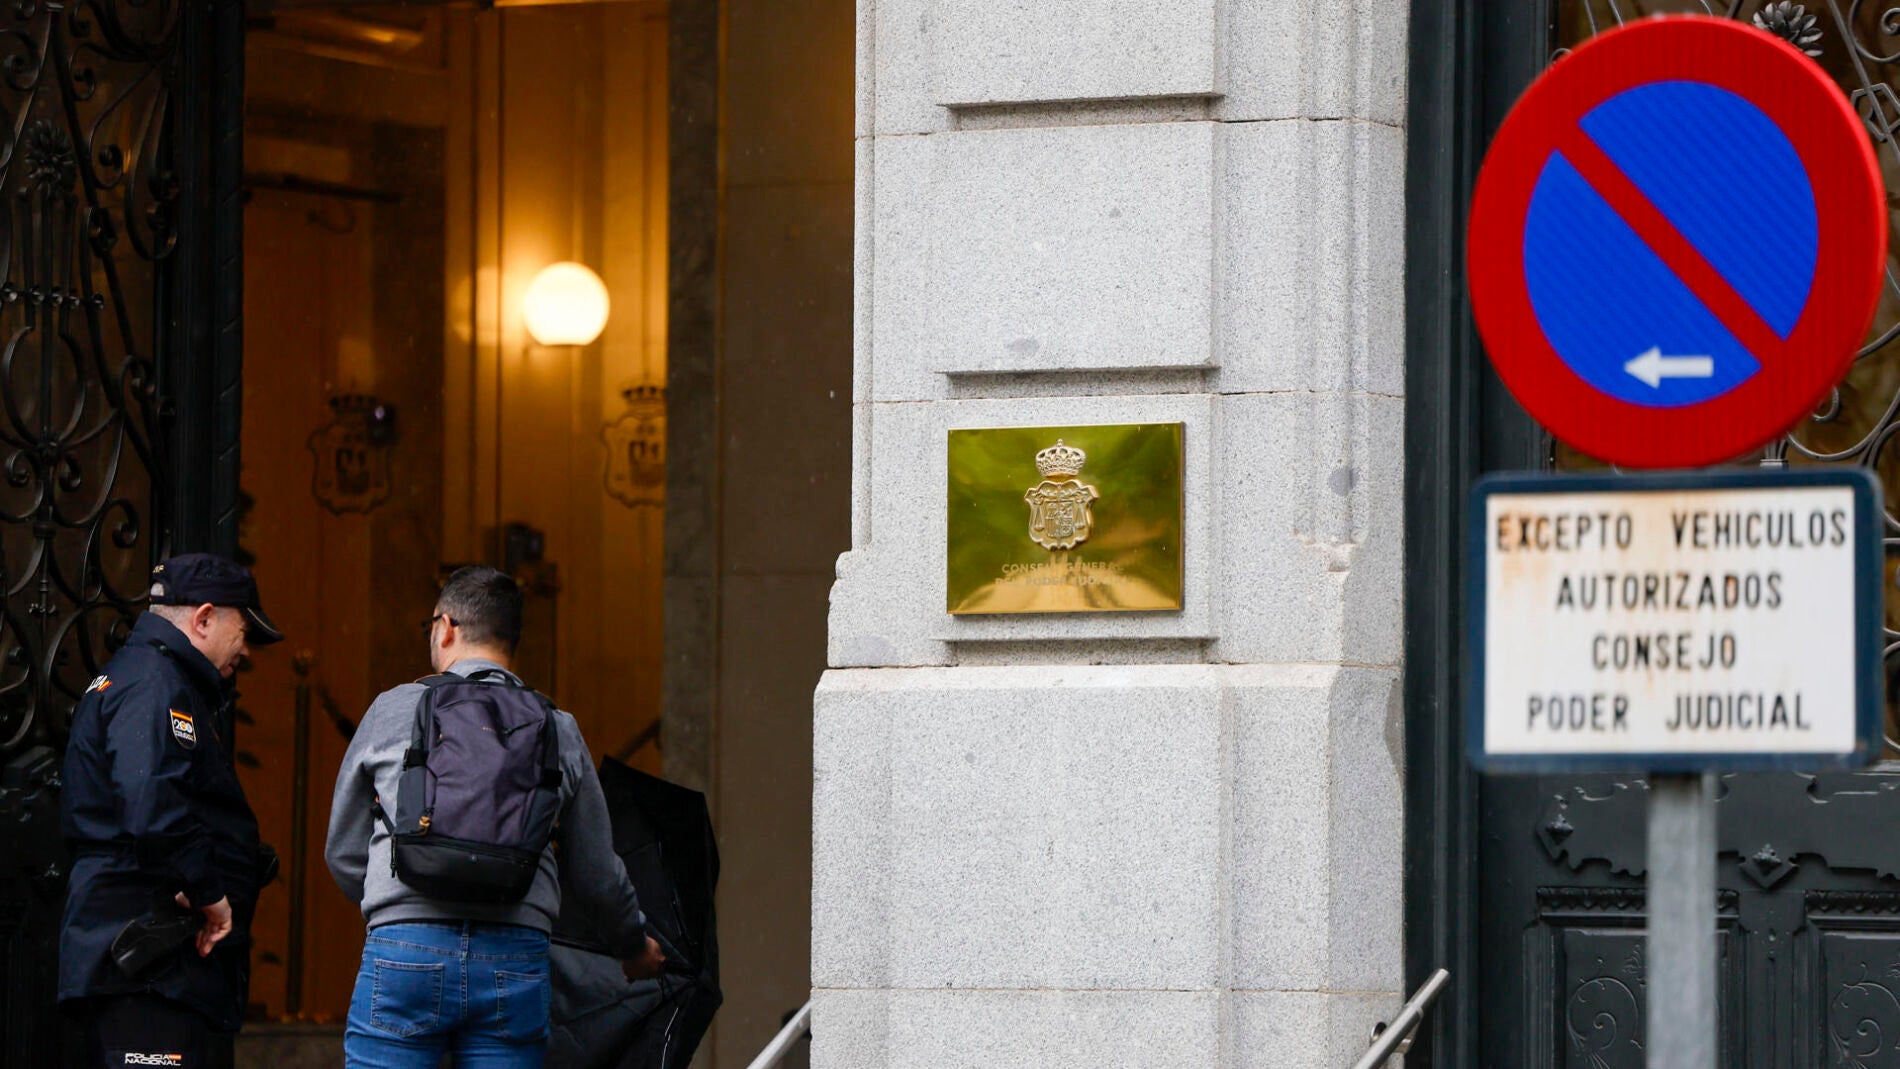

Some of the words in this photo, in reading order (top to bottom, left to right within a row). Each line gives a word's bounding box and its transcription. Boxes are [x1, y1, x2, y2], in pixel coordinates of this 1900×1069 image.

[1496, 511, 1633, 551] EXCEPTO
[1671, 508, 1847, 549] VEHICULOS
[1556, 572, 1783, 610] AUTORIZADOS
[1592, 633, 1737, 671] CONSEJO
[1528, 694, 1629, 731] PODER
[1665, 693, 1811, 731] JUDICIAL
[124, 1052, 170, 1060] POLICIA
[124, 1058, 181, 1066] NACIONAL
